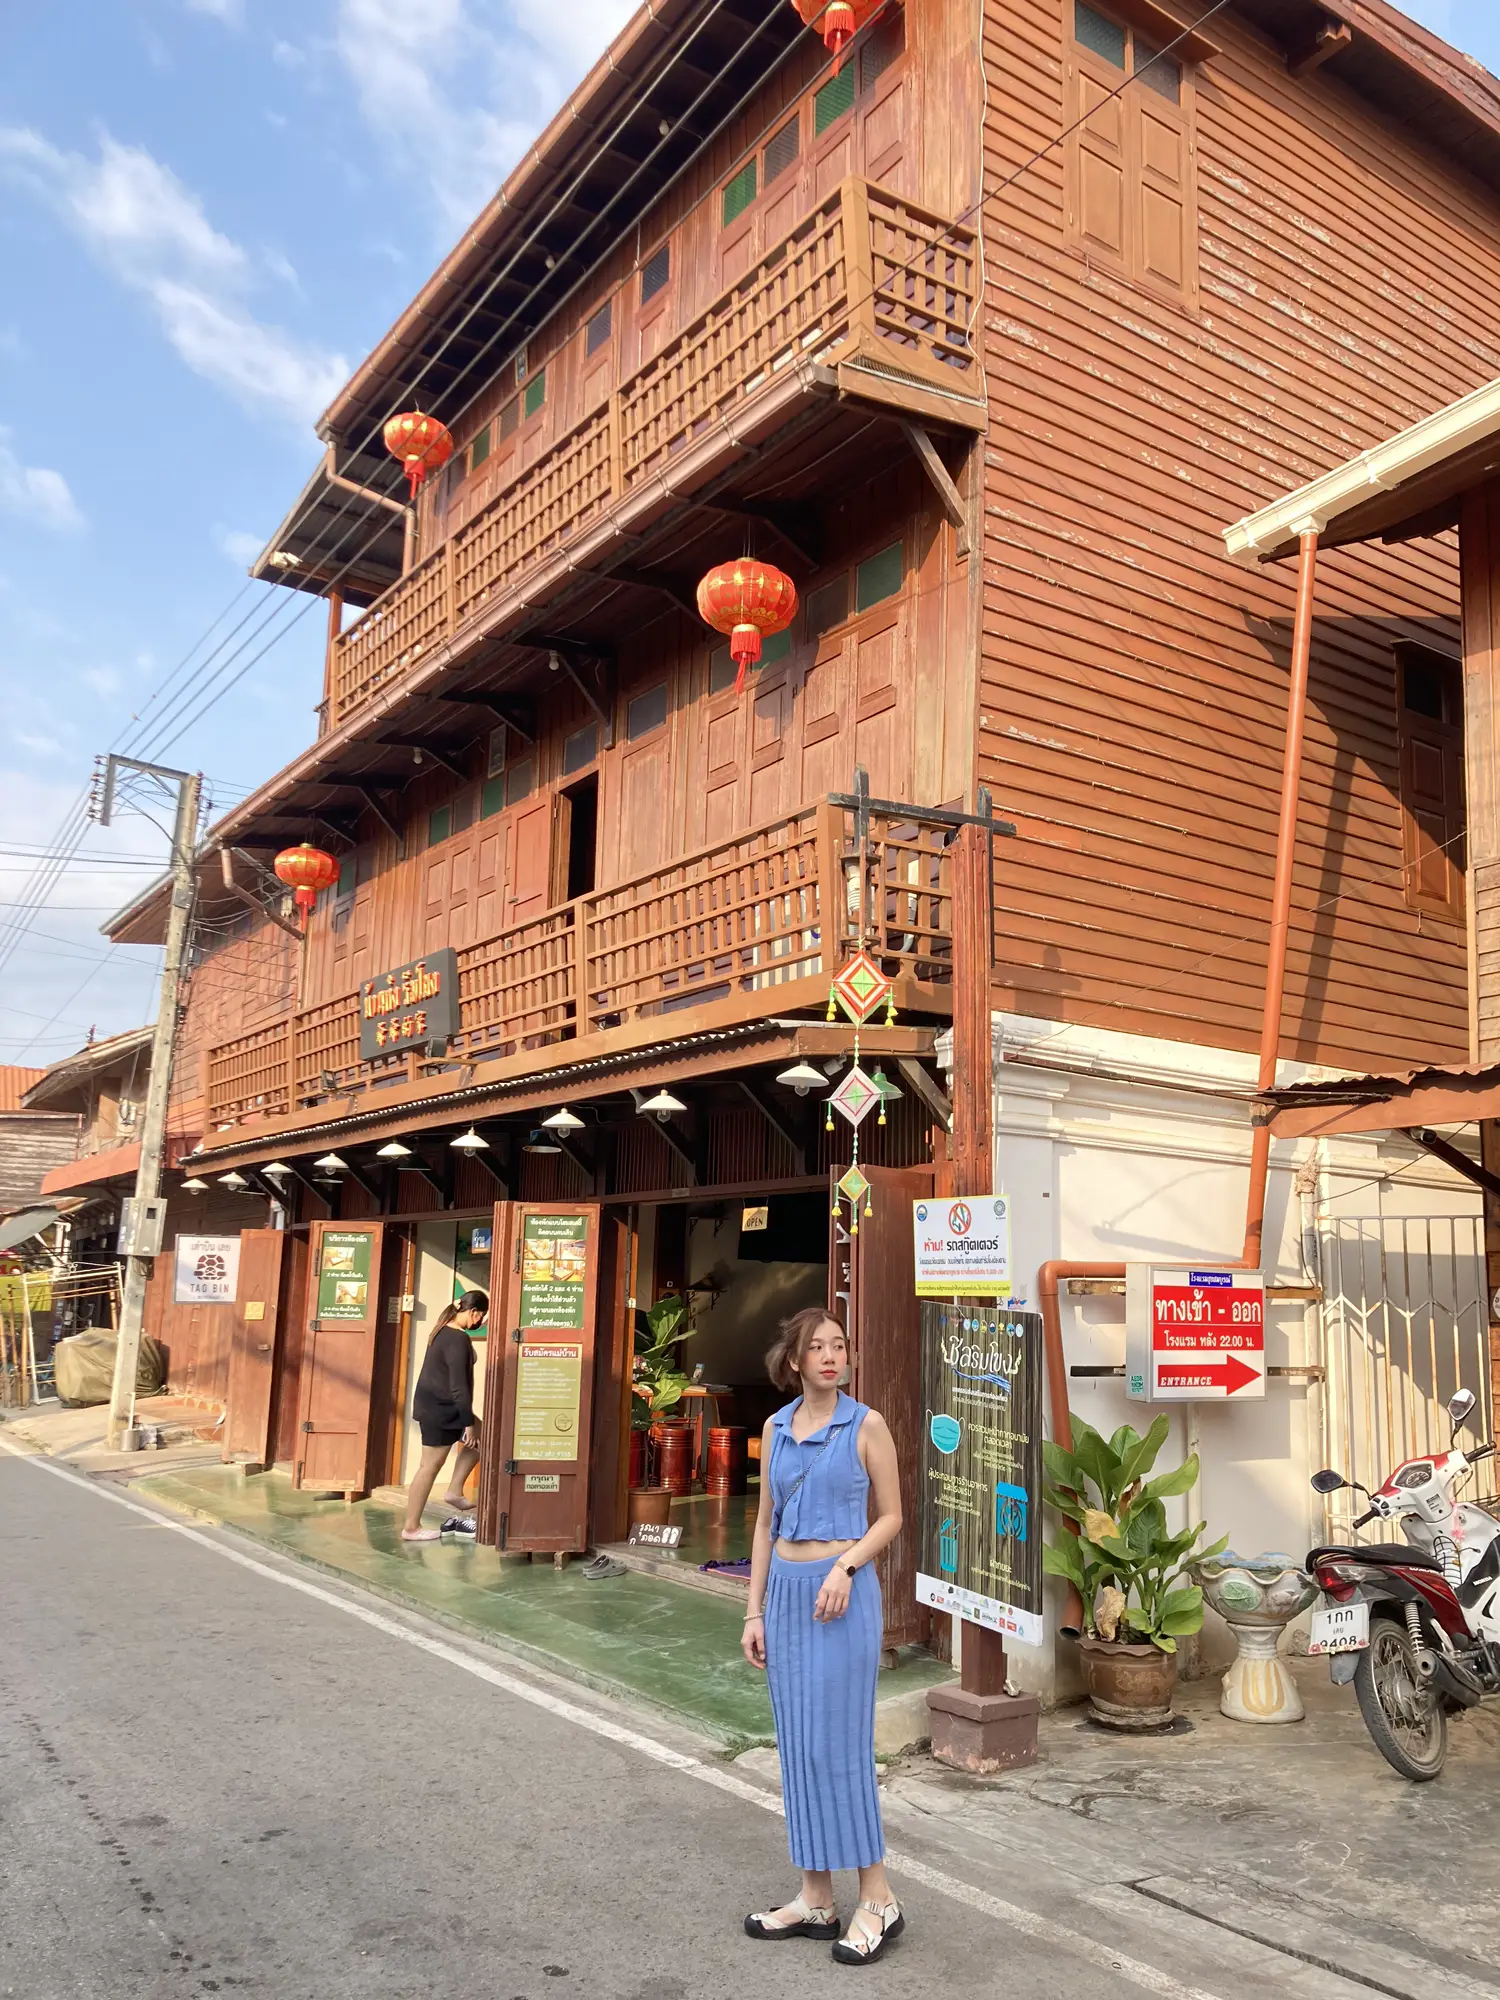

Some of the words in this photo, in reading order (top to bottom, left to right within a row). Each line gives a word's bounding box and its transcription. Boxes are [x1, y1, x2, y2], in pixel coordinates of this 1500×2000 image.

[746, 1217, 763, 1228] OPEN
[923, 1237, 943, 1252] ห้าม!
[213, 1283, 229, 1293] BIN
[1155, 1288, 1211, 1321] ทางเข้า
[1232, 1301, 1262, 1322] ออก
[1164, 1329, 1197, 1347] โรงแรม
[1200, 1332, 1217, 1347] หลัง
[1220, 1335, 1243, 1347] 22.00
[1246, 1337, 1254, 1347] น.
[524, 1347, 577, 1357] รับสมัครแม่บ้าน
[1160, 1376, 1212, 1386] ENTRANCE
[968, 1423, 1029, 1443] ควรสวมหน้ากากอนามัย
[984, 1435, 1012, 1449] ตลอดเวลา
[928, 1467, 988, 1492] ผู้ประกอบการร้านอาหาร
[943, 1482, 972, 1497] และโรงแรม
[1327, 1610, 1353, 1625] 1กก
[1320, 1635, 1357, 1647] 9408
